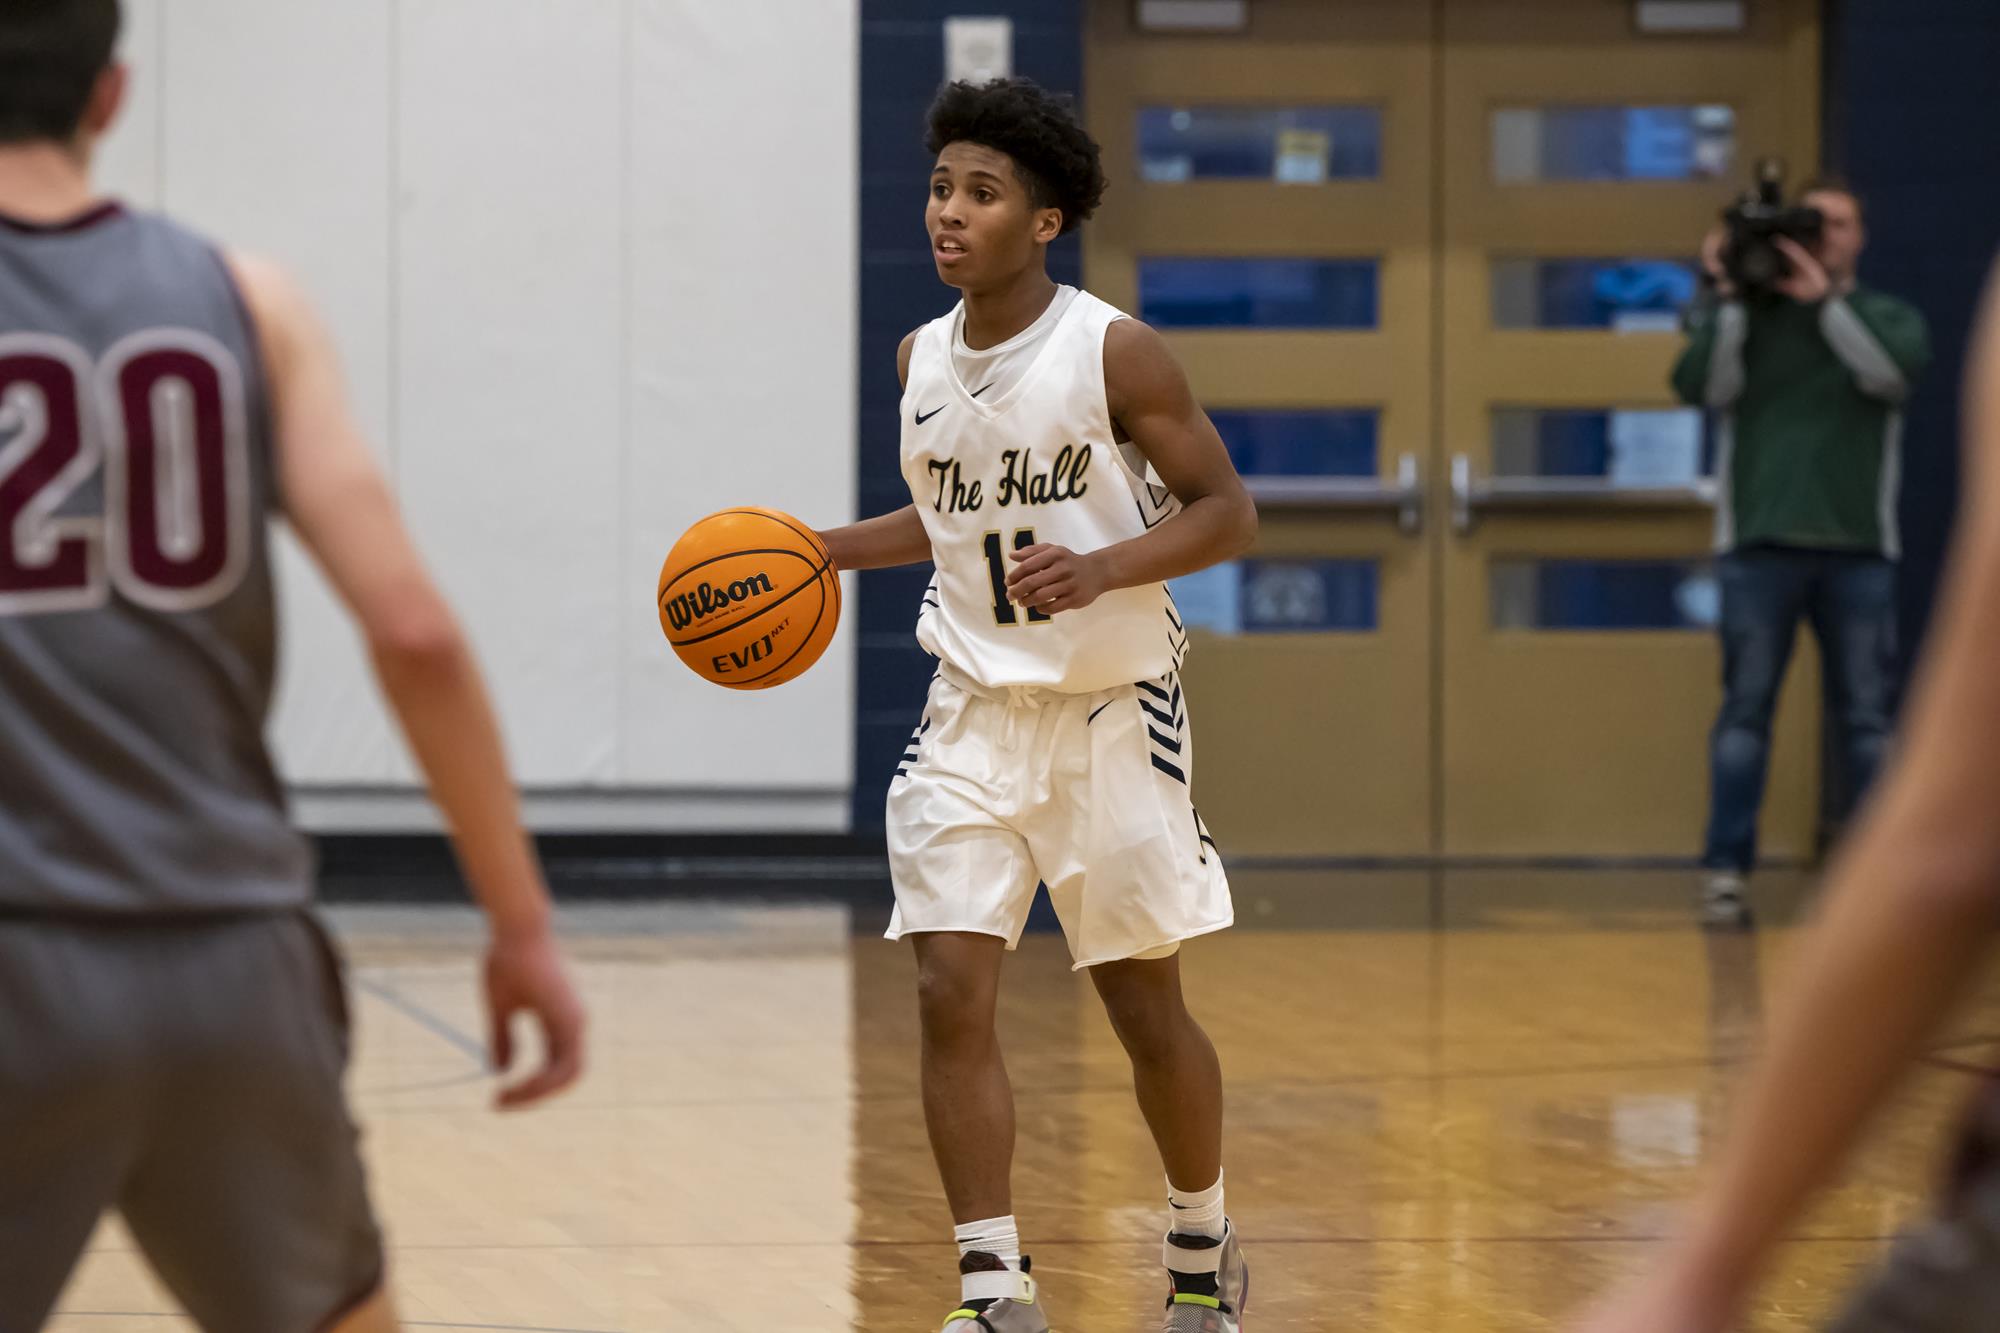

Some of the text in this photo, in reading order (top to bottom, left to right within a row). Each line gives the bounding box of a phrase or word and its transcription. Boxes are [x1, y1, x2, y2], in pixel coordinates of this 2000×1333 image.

[0, 327, 249, 612] 20
[928, 444, 1092, 513] The Hall
[664, 572, 774, 631] Wilson
[712, 634, 773, 673] EVO
